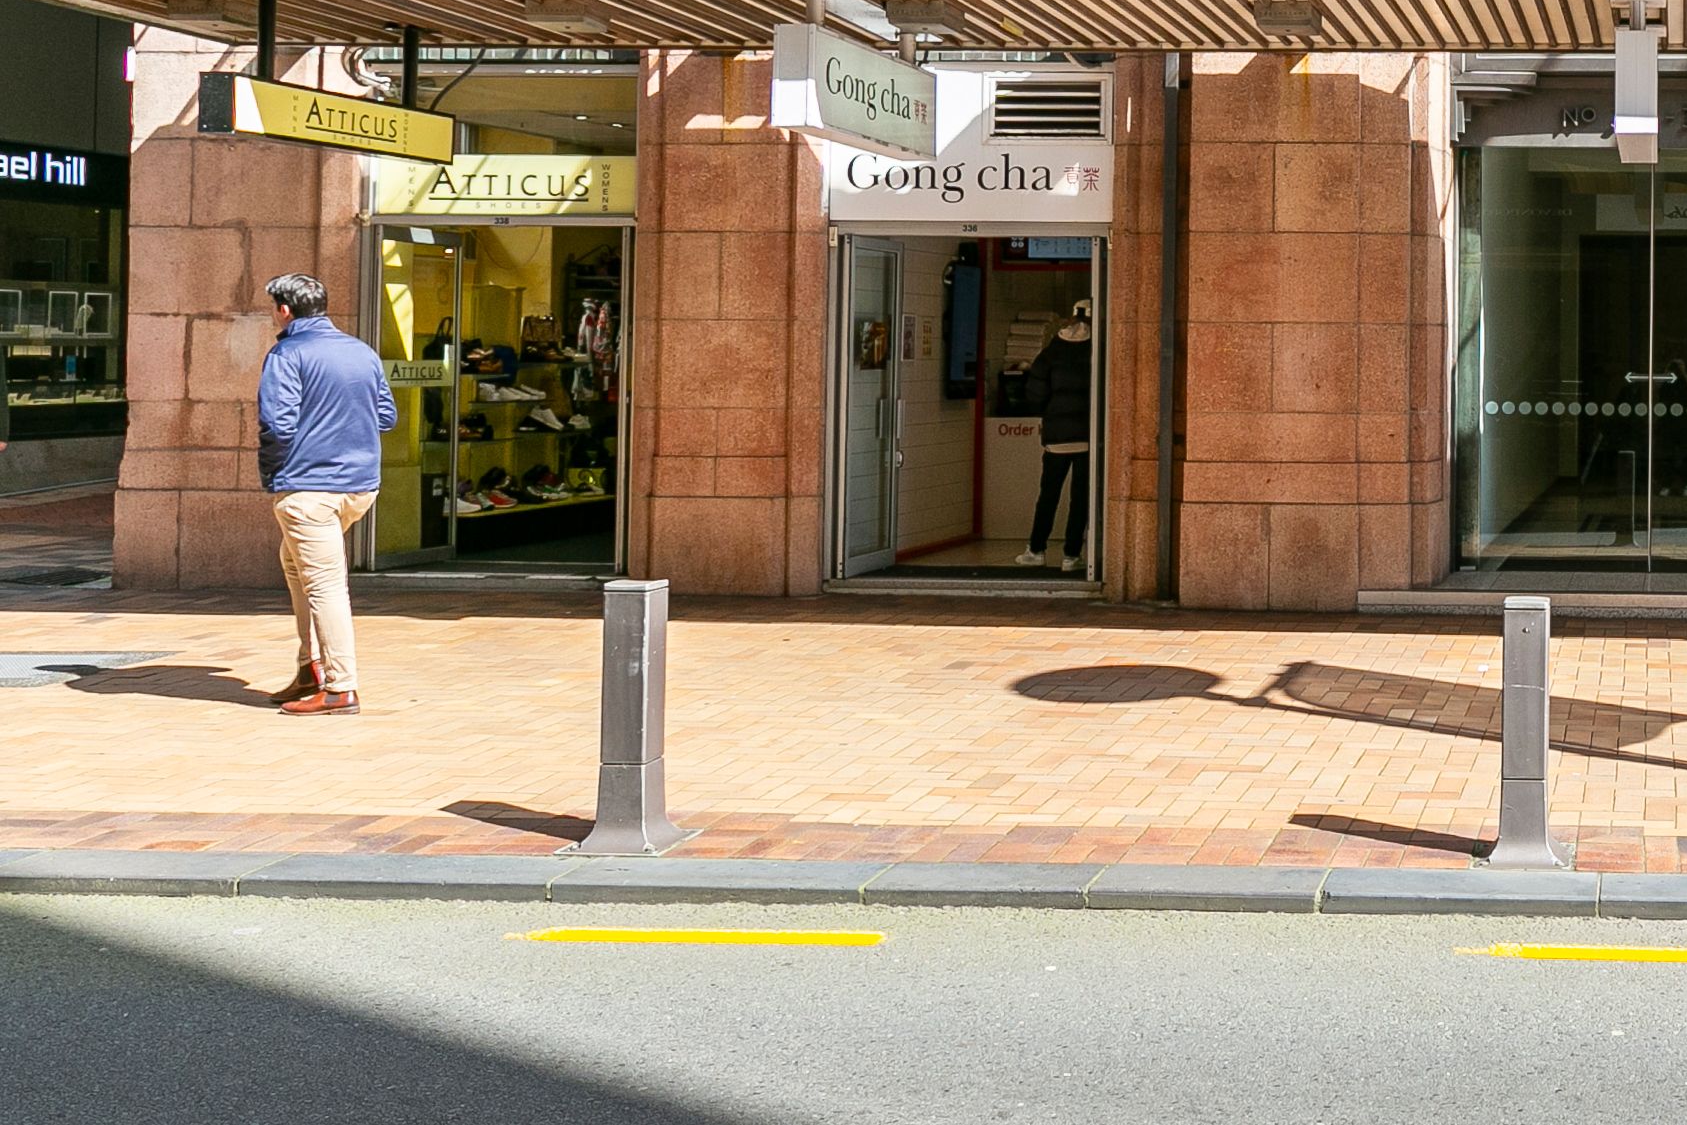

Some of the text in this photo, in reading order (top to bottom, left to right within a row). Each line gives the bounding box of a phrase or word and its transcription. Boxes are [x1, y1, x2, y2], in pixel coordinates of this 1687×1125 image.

[825, 56, 911, 121] Gong cha
[305, 96, 398, 138] ATTICUS
[45, 152, 86, 187] hill
[408, 166, 416, 208] MENS
[429, 165, 590, 197] ATTICUS
[601, 164, 611, 212] WOMENS
[847, 152, 1054, 204] Gong cha
[475, 201, 541, 210] SHOES
[390, 363, 443, 378] ATTICUS
[998, 423, 1035, 437] Order
